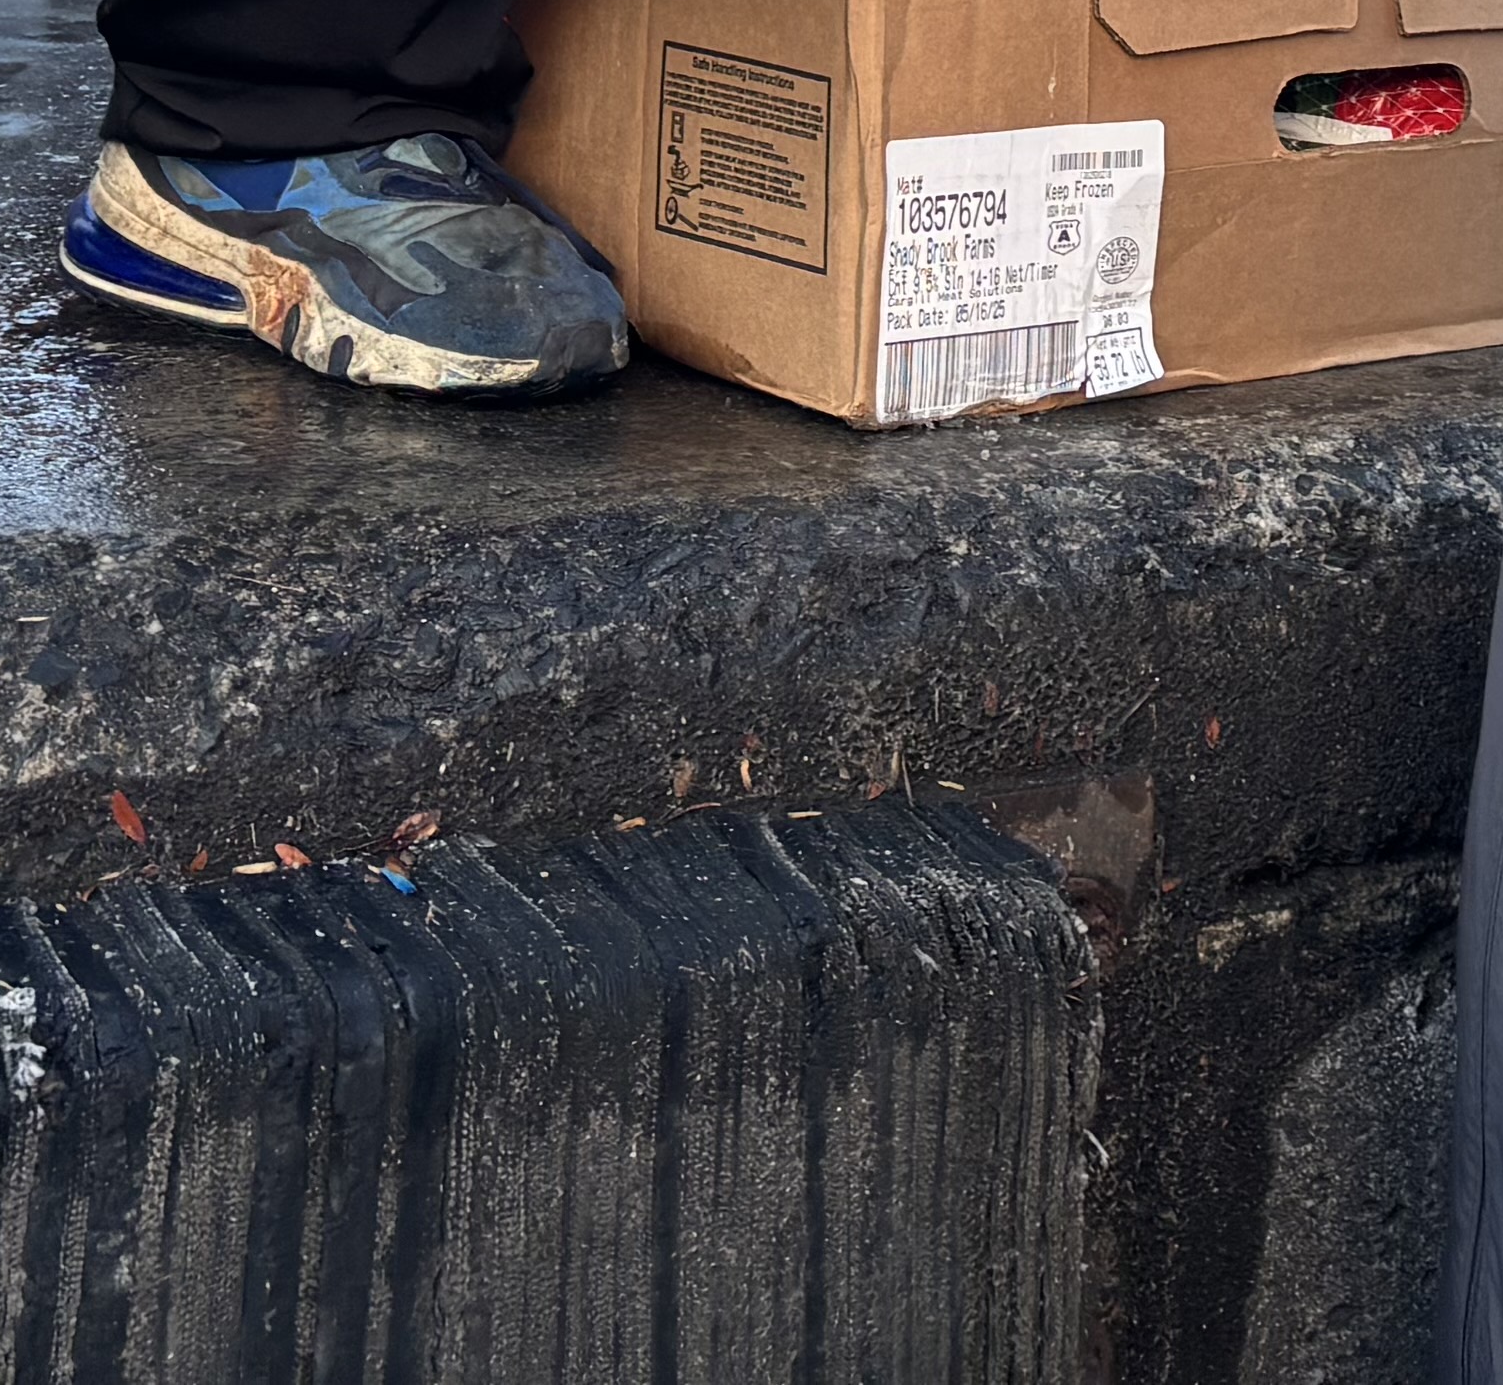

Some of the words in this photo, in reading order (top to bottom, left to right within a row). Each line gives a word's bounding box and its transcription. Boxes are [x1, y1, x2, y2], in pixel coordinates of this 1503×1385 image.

[692, 56, 710, 72] Safe
[711, 59, 747, 82] Handling
[897, 176, 923, 195] Mat#
[1045, 183, 1069, 201] Keep
[1075, 180, 1114, 198] Frozen
[899, 189, 1007, 235] 103576794
[1057, 229, 1071, 243] A
[890, 240, 921, 270] Shady
[927, 236, 958, 265] Brook
[964, 233, 996, 261] Farms
[970, 267, 1001, 287] 14-16
[970, 284, 1023, 298] Solutions
[888, 311, 912, 331] Pack
[919, 308, 948, 328] Date:
